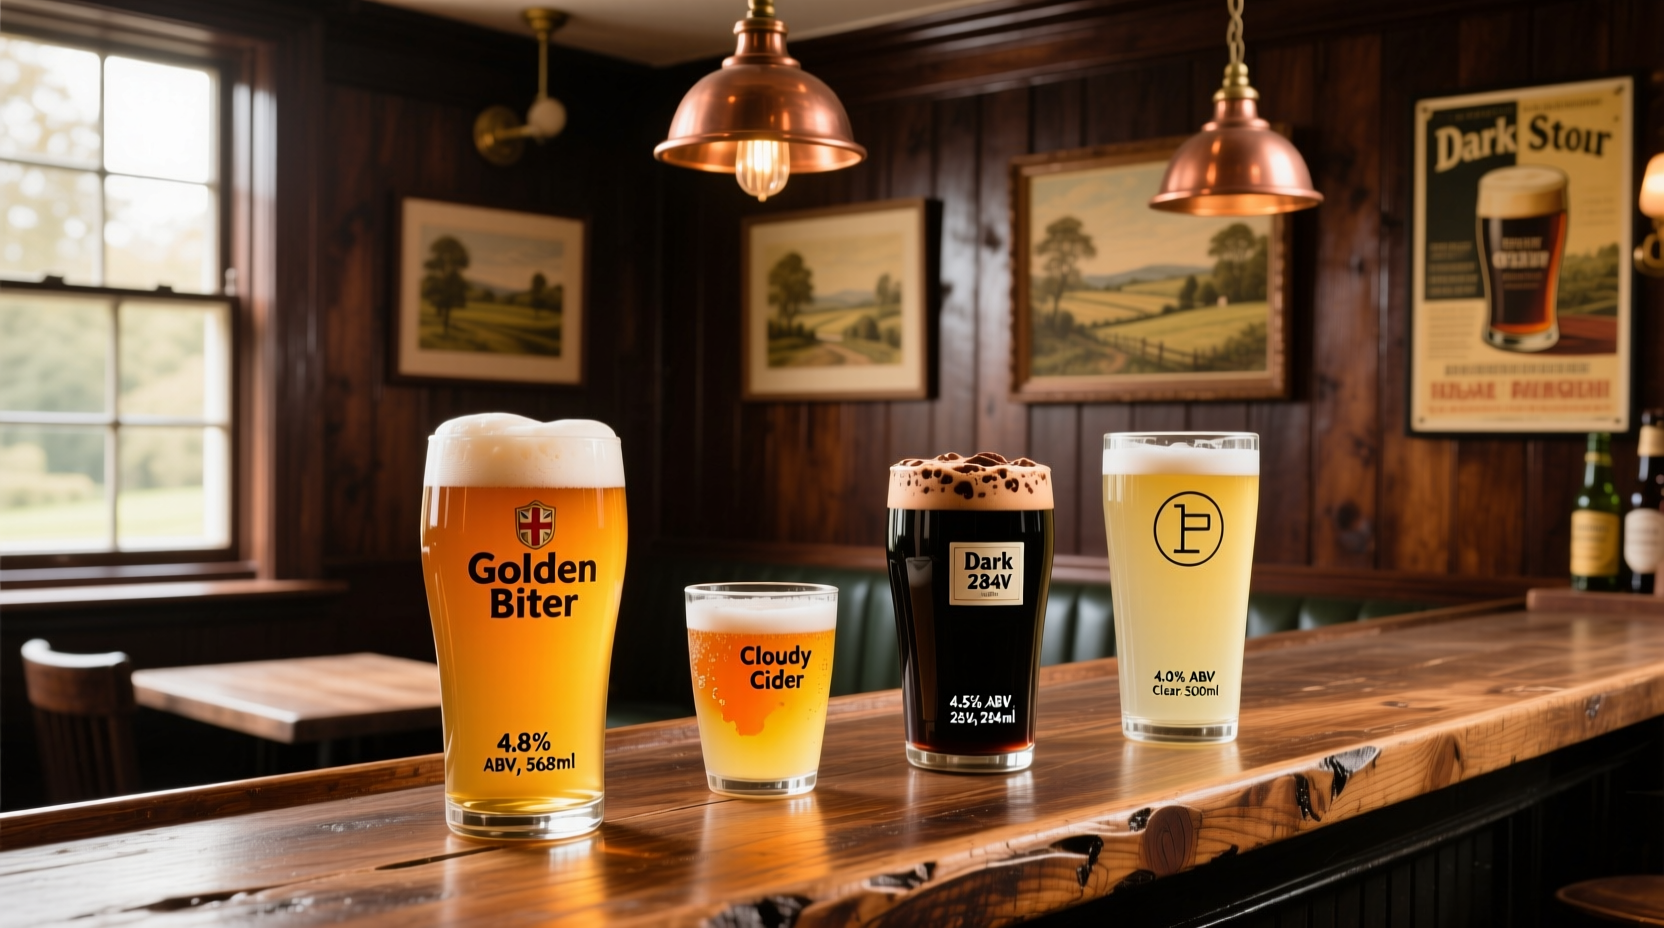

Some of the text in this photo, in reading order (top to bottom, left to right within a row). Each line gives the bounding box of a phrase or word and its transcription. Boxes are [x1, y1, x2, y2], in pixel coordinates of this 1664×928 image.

[1434, 115, 1517, 173] Dark
[468, 551, 597, 585] Golden
[964, 551, 1014, 571] Dark
[490, 587, 579, 619] Biter
[740, 644, 812, 670] Cloudy
[750, 669, 805, 690] Cider
[1154, 669, 1216, 683] 4.0% ABV
[1184, 684, 1219, 697] 500ml
[497, 731, 551, 753] 4.8%
[483, 752, 575, 777] ABV, 568ml
